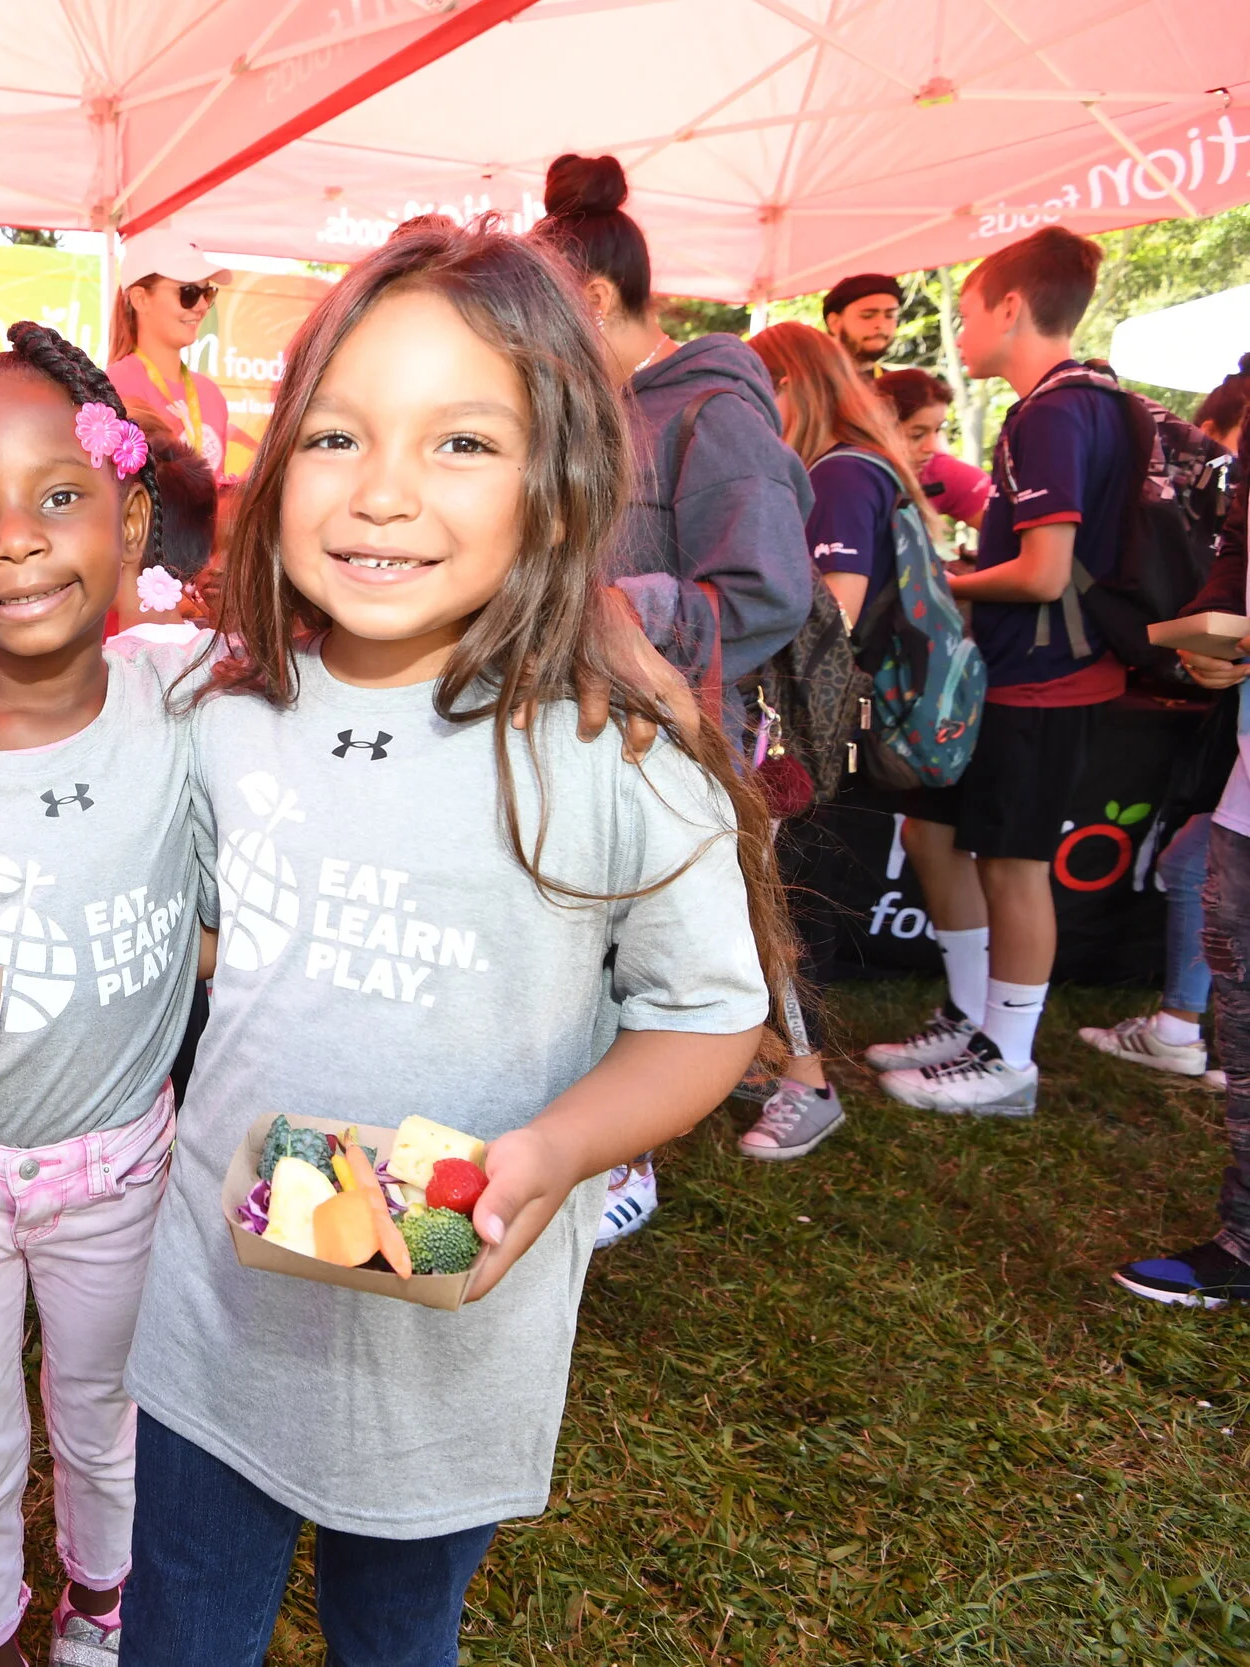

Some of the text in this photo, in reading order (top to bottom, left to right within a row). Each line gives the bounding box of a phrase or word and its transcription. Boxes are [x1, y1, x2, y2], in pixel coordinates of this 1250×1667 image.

[224, 346, 284, 382] food
[84, 886, 155, 936] EAT.
[319, 857, 417, 912] EAT.
[312, 900, 490, 972] LEARN.
[97, 938, 174, 1006] PLAY.
[305, 941, 435, 1007] PLAY.
